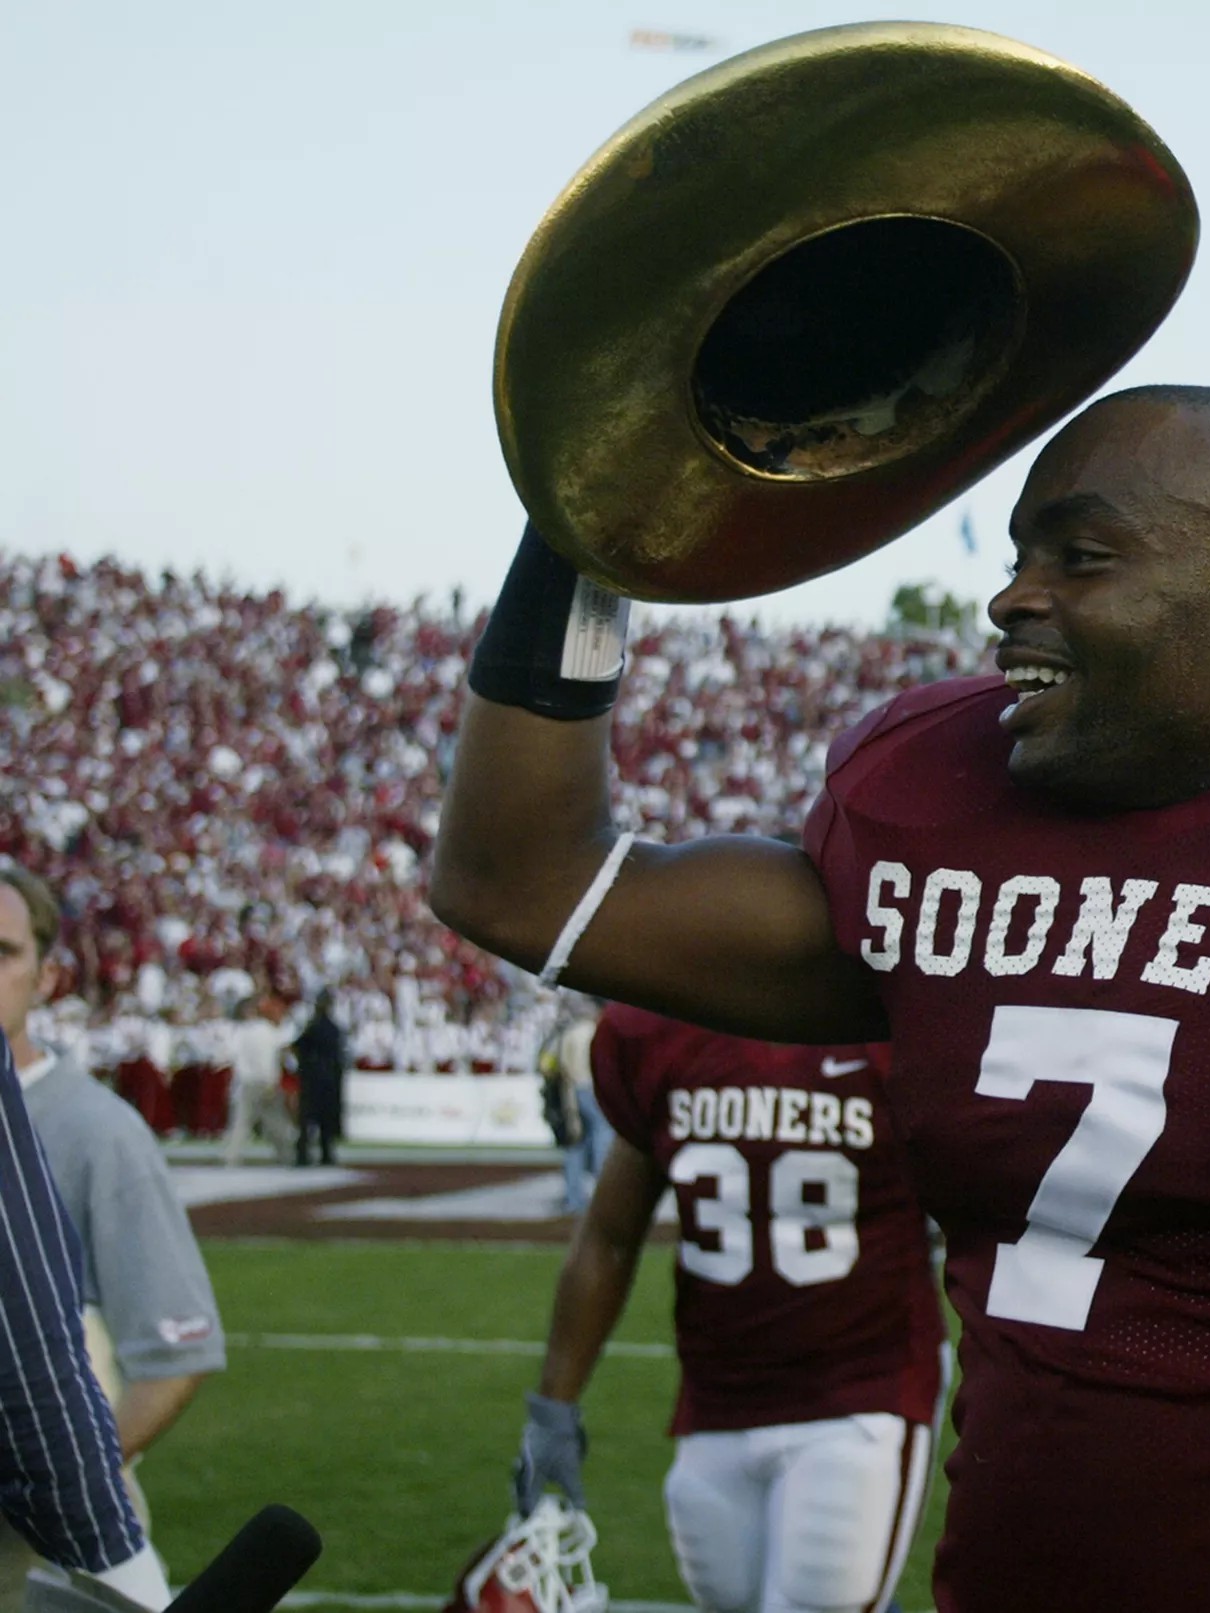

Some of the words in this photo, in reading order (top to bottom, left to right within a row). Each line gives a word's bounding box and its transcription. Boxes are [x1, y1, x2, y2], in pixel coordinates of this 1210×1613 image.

[668, 1086, 875, 1149] SOONERS
[974, 1005, 1180, 1332] 7
[669, 1142, 860, 1287] 38
